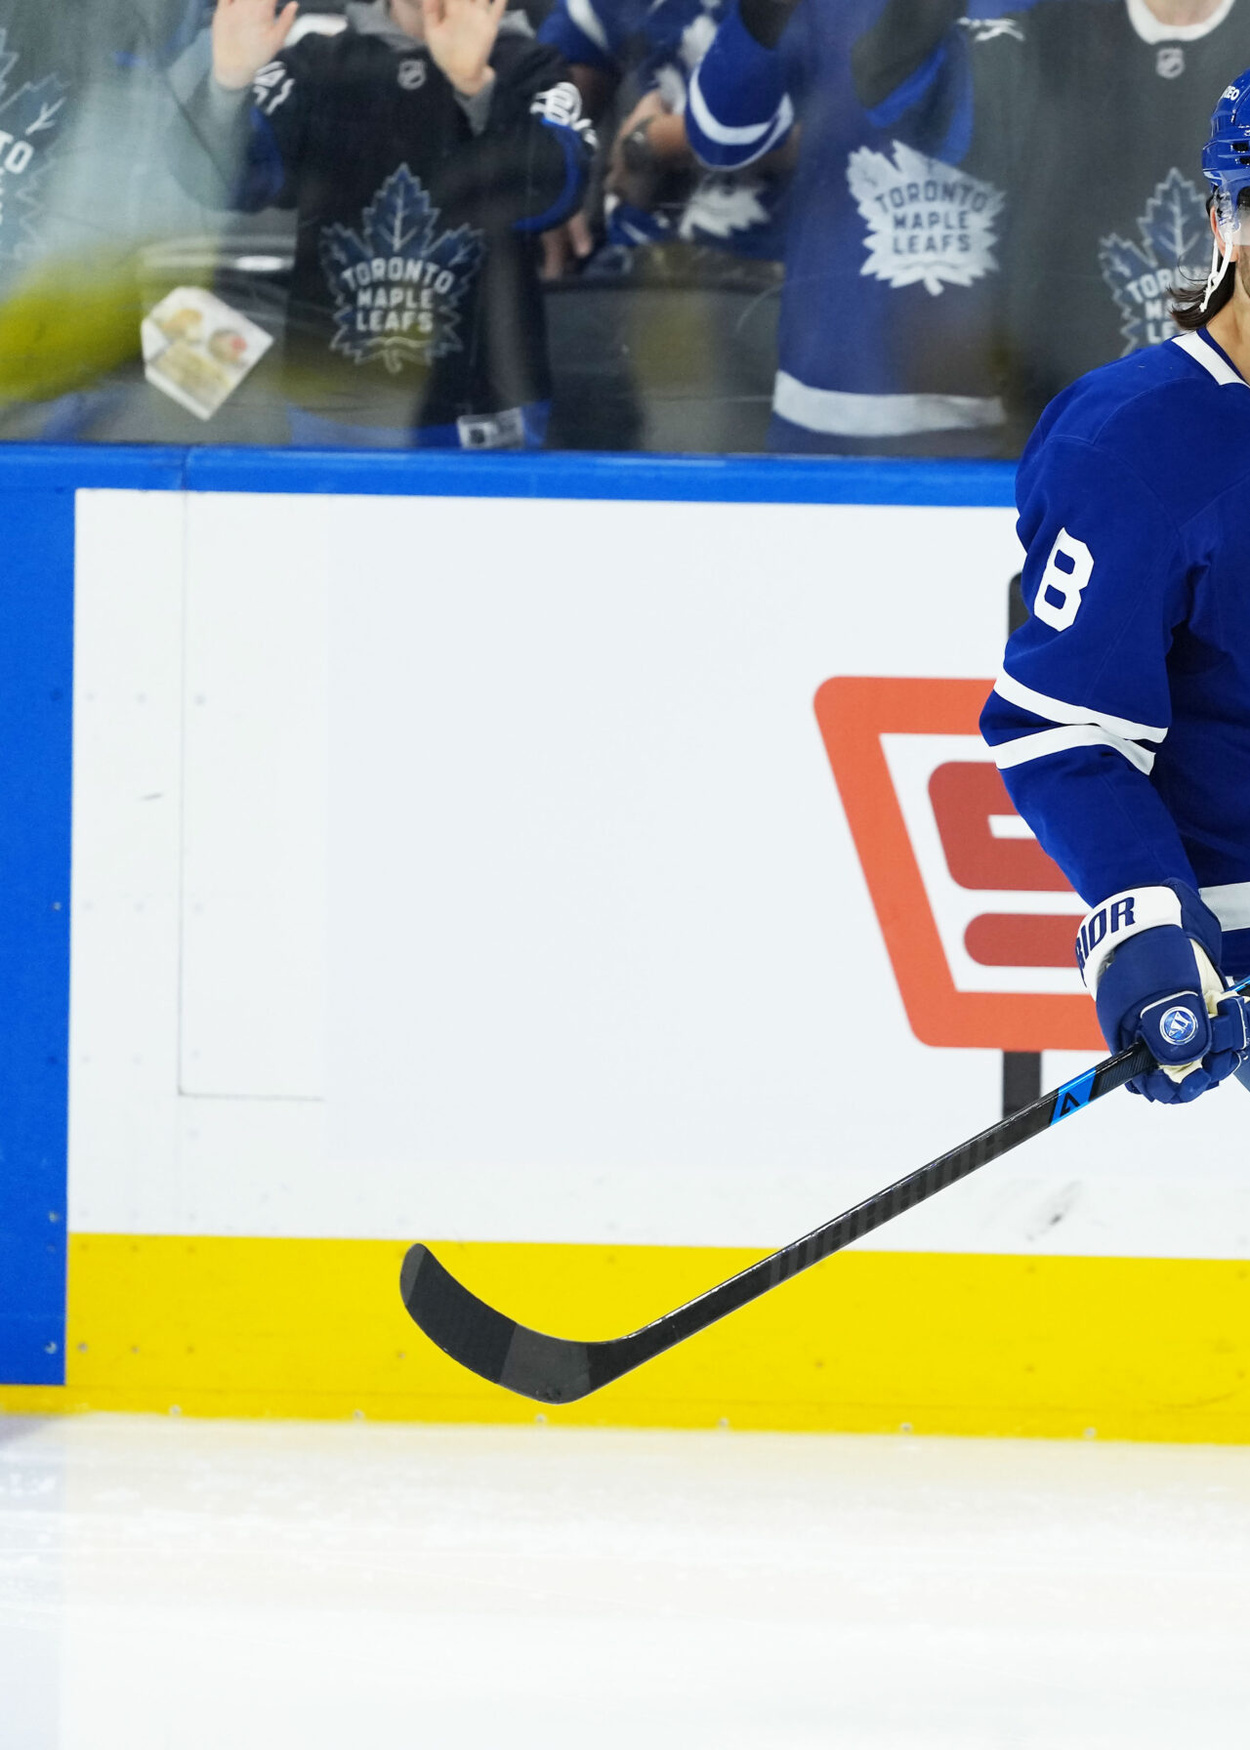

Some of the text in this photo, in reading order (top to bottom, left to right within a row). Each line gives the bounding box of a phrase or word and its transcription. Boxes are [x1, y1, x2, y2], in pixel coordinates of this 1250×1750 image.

[874, 179, 989, 214] TORONTO
[893, 210, 969, 230] MAPLE
[893, 234, 970, 255] LEAFS
[341, 256, 456, 295] TORONTO
[356, 286, 434, 309] MAPLE
[356, 310, 434, 332] LEAFS
[1033, 526, 1095, 633] 8
[1075, 896, 1137, 970] RIOR
